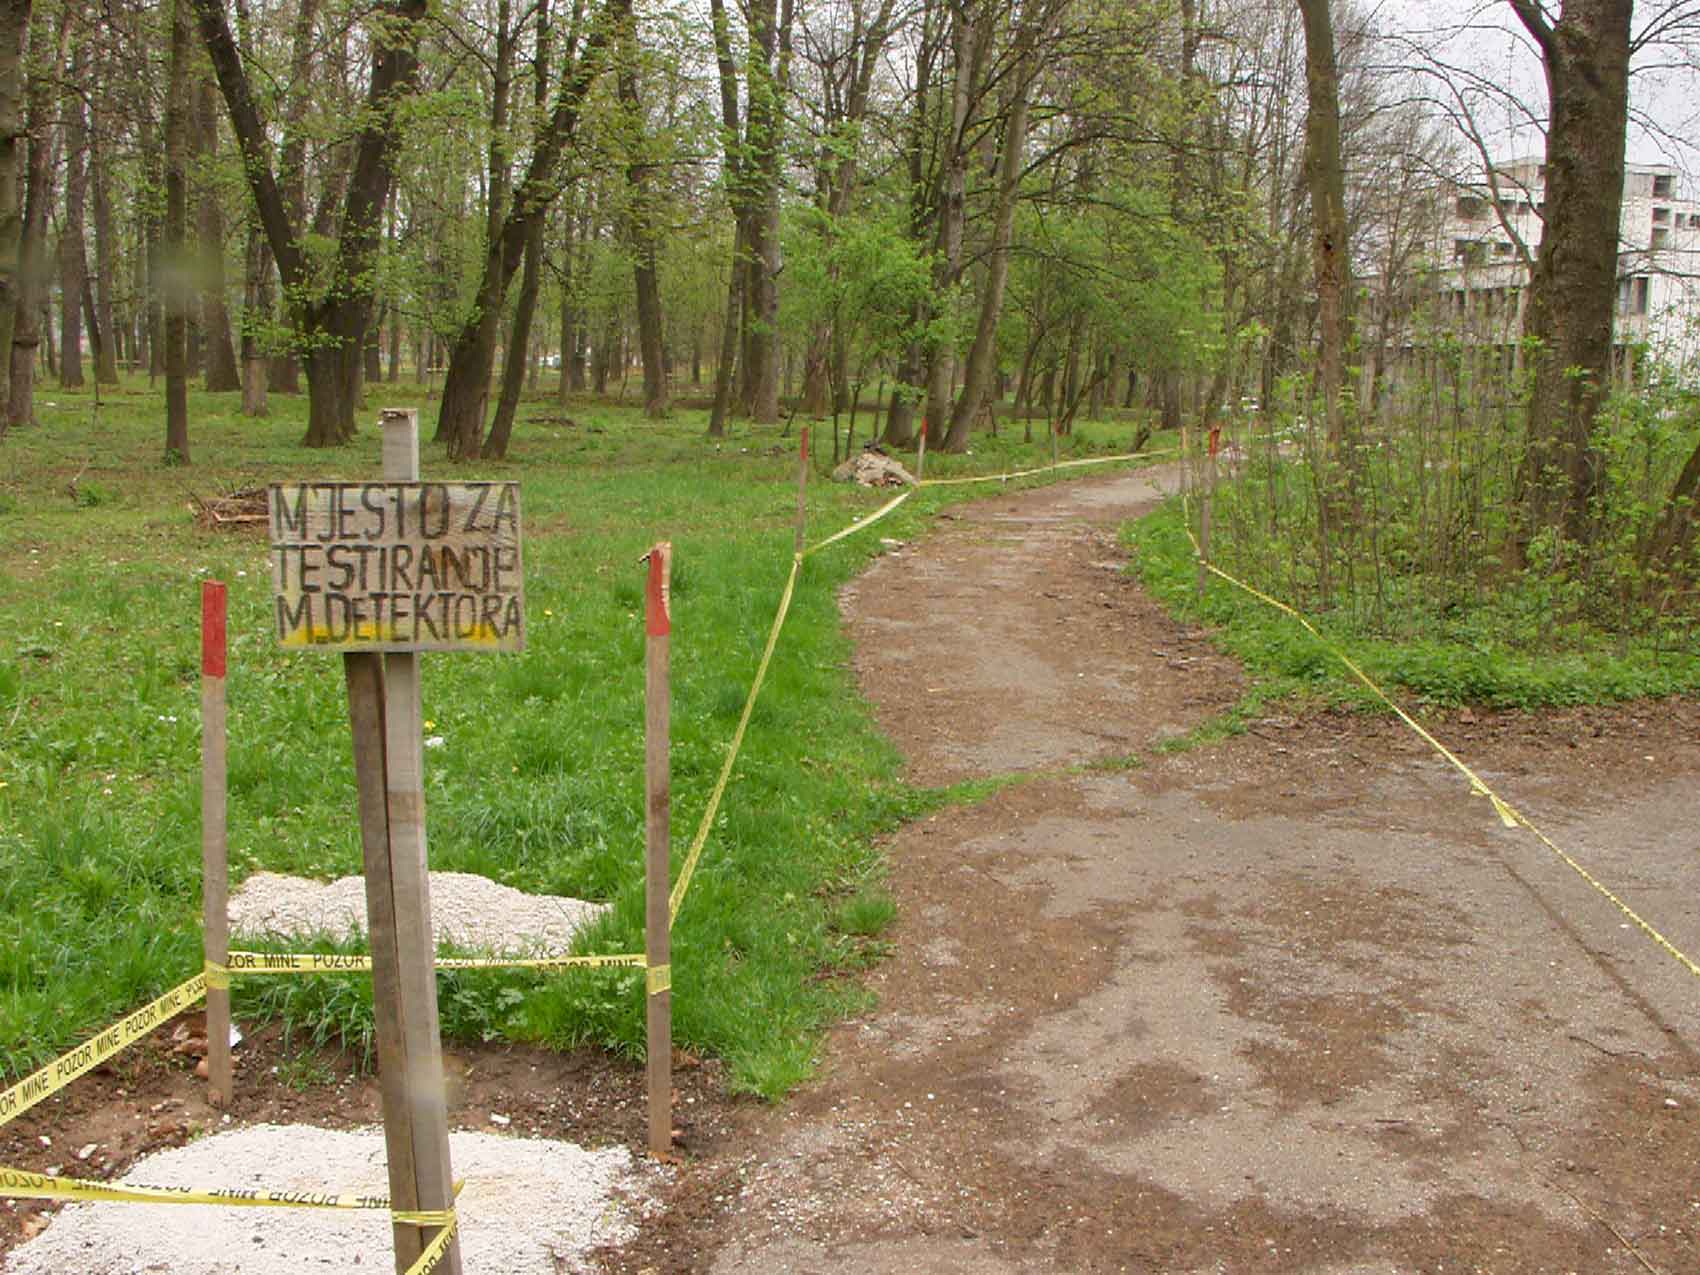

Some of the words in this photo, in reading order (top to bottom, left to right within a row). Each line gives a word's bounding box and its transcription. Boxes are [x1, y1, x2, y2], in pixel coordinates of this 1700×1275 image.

[273, 483, 450, 541] MJESTO
[463, 483, 517, 533] ZA
[272, 544, 519, 593] TESTIRANJE
[264, 953, 301, 969] MINE
[22, 1070, 49, 1101] MINE
[56, 1045, 93, 1081] POZOR
[96, 1026, 121, 1057] MINE
[125, 1006, 157, 1038] POZOR
